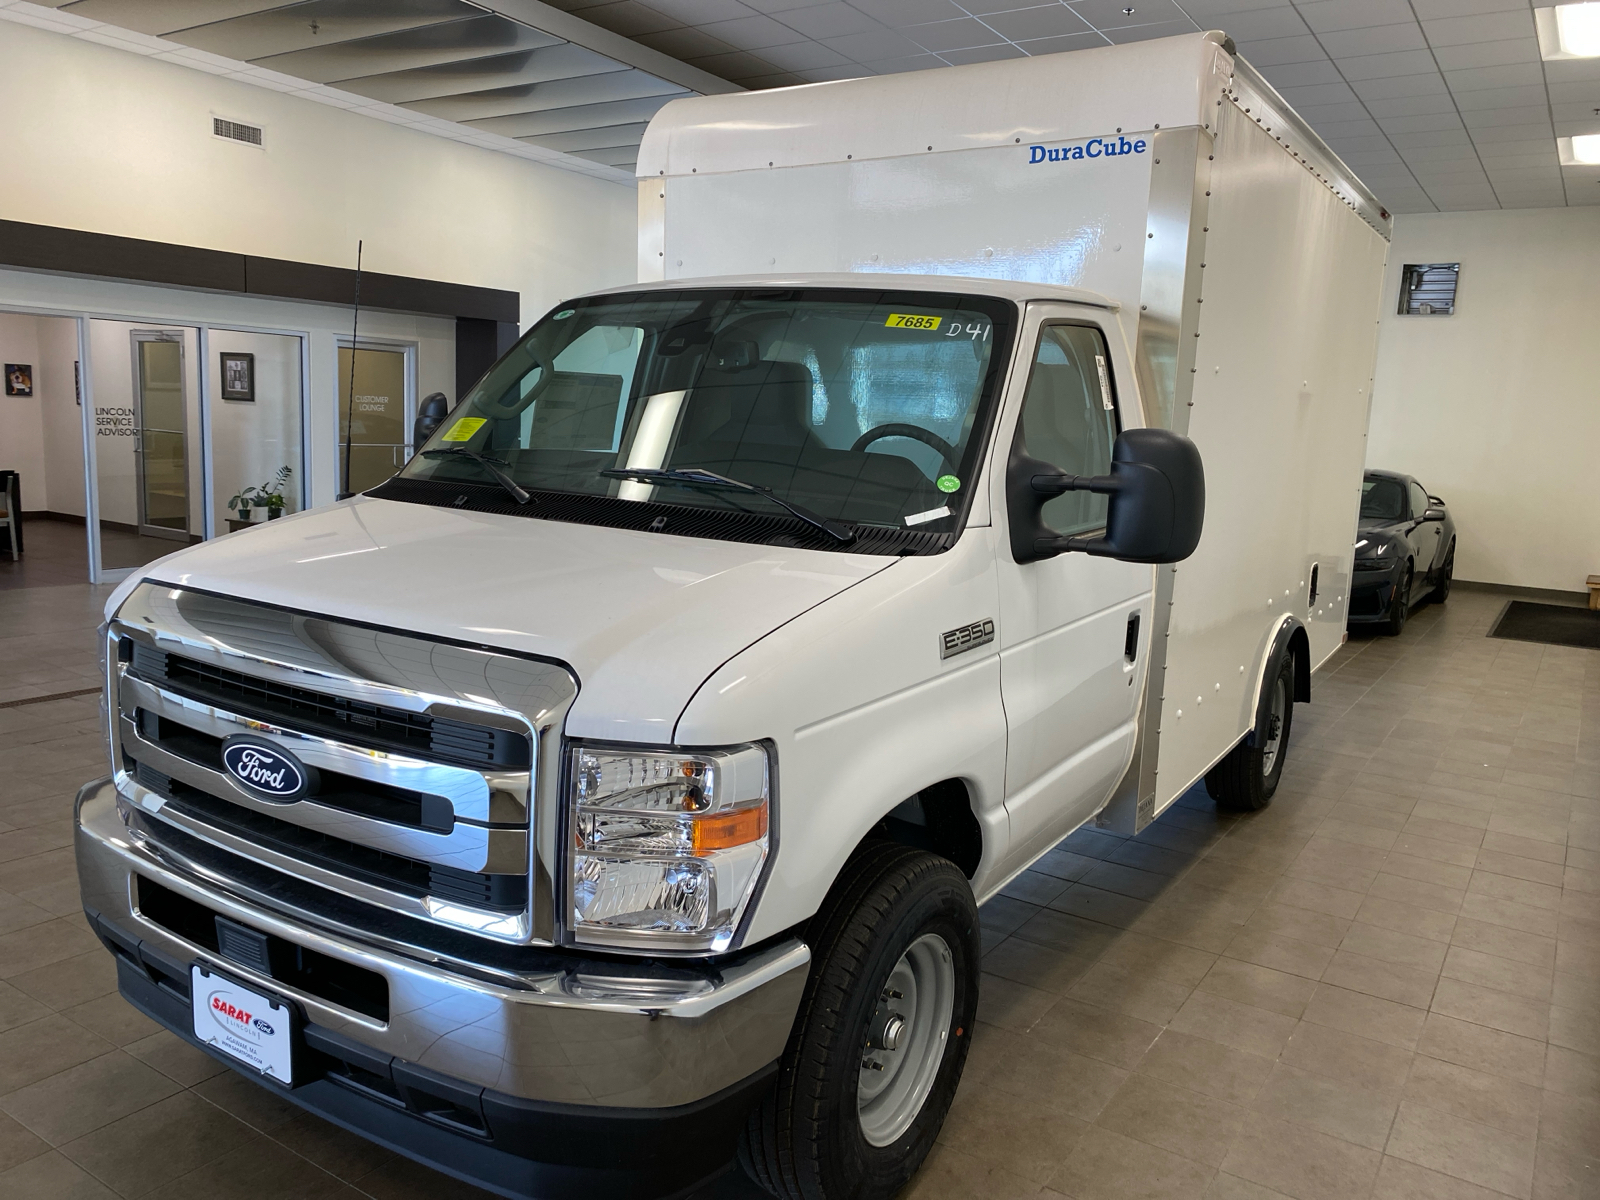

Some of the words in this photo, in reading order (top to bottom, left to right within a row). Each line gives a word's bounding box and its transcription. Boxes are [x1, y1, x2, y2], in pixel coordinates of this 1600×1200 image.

[1028, 136, 1147, 164] DuraCube
[895, 315, 935, 329] 7685
[354, 395, 389, 404] CUSTOMER
[95, 407, 136, 416] LINCOLN
[359, 404, 386, 412] LOUNGE
[96, 417, 133, 426] SERVICE
[96, 427, 139, 437] ADVISOR
[943, 619, 995, 650] E-350
[237, 749, 286, 789] Ford
[212, 997, 252, 1025] SARAT
[230, 1020, 256, 1037] LINCOLN
[256, 1020, 272, 1034] Ford
